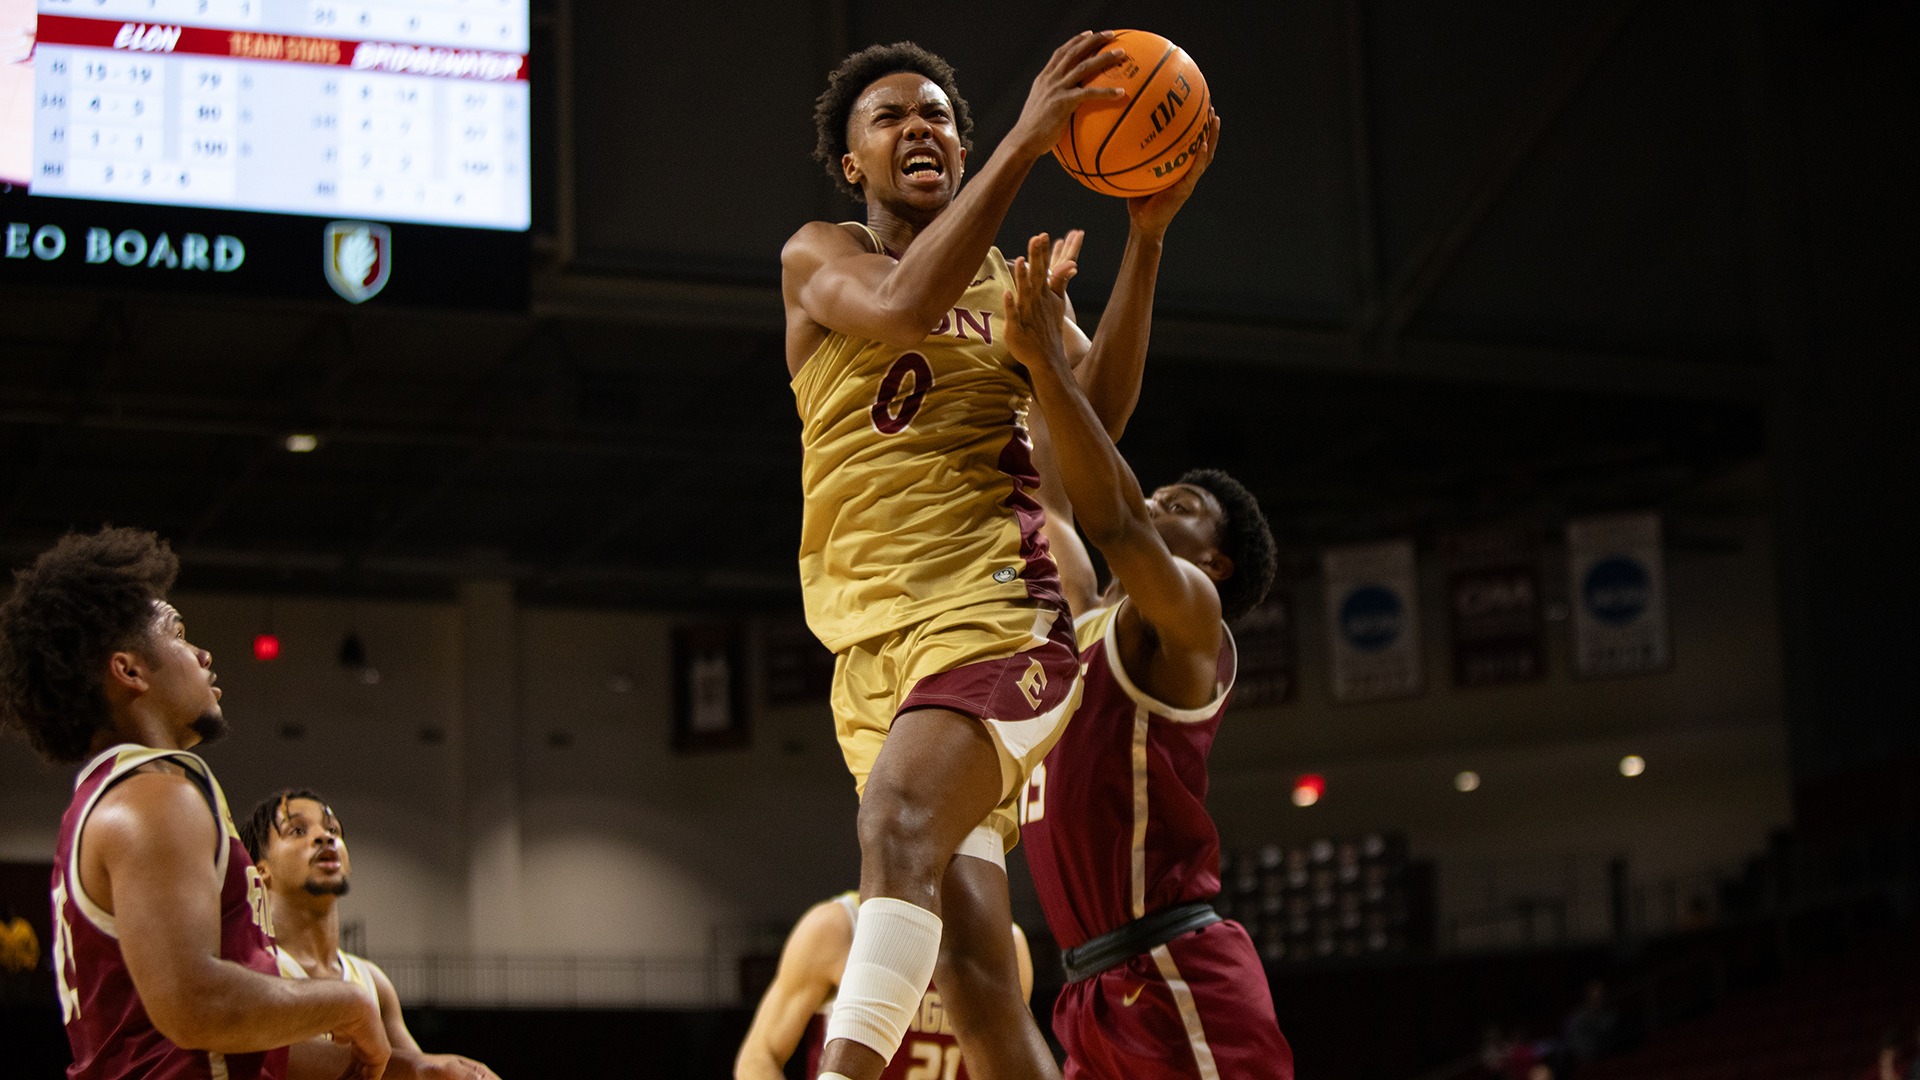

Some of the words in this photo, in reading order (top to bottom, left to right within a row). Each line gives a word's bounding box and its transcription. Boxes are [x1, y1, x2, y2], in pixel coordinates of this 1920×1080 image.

[113, 23, 182, 52] ELON
[230, 32, 284, 59] TEAM
[285, 37, 341, 64] STATS
[351, 41, 523, 81] BRIDGEWATER
[0, 222, 67, 261] EO
[85, 226, 246, 273] BOARD
[870, 349, 936, 438] 0
